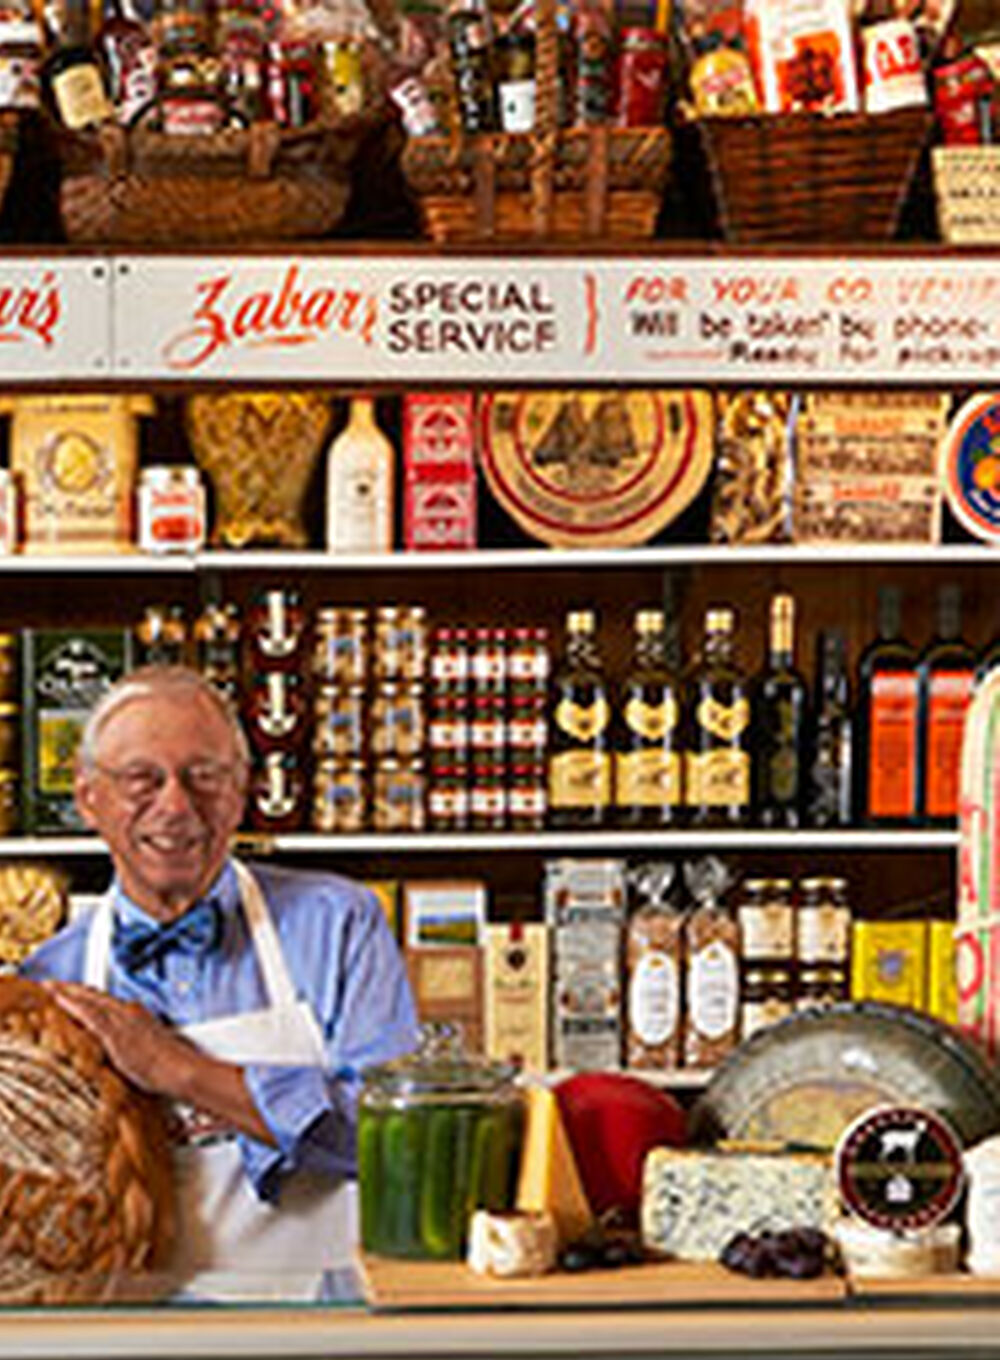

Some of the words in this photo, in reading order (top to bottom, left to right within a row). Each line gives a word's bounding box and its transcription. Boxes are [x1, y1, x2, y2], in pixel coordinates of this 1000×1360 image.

[389, 281, 554, 316] SPECIAL
[626, 277, 687, 301] FOR
[388, 320, 556, 354] SERVICE
[632, 312, 678, 337] Will
[700, 312, 732, 339] be
